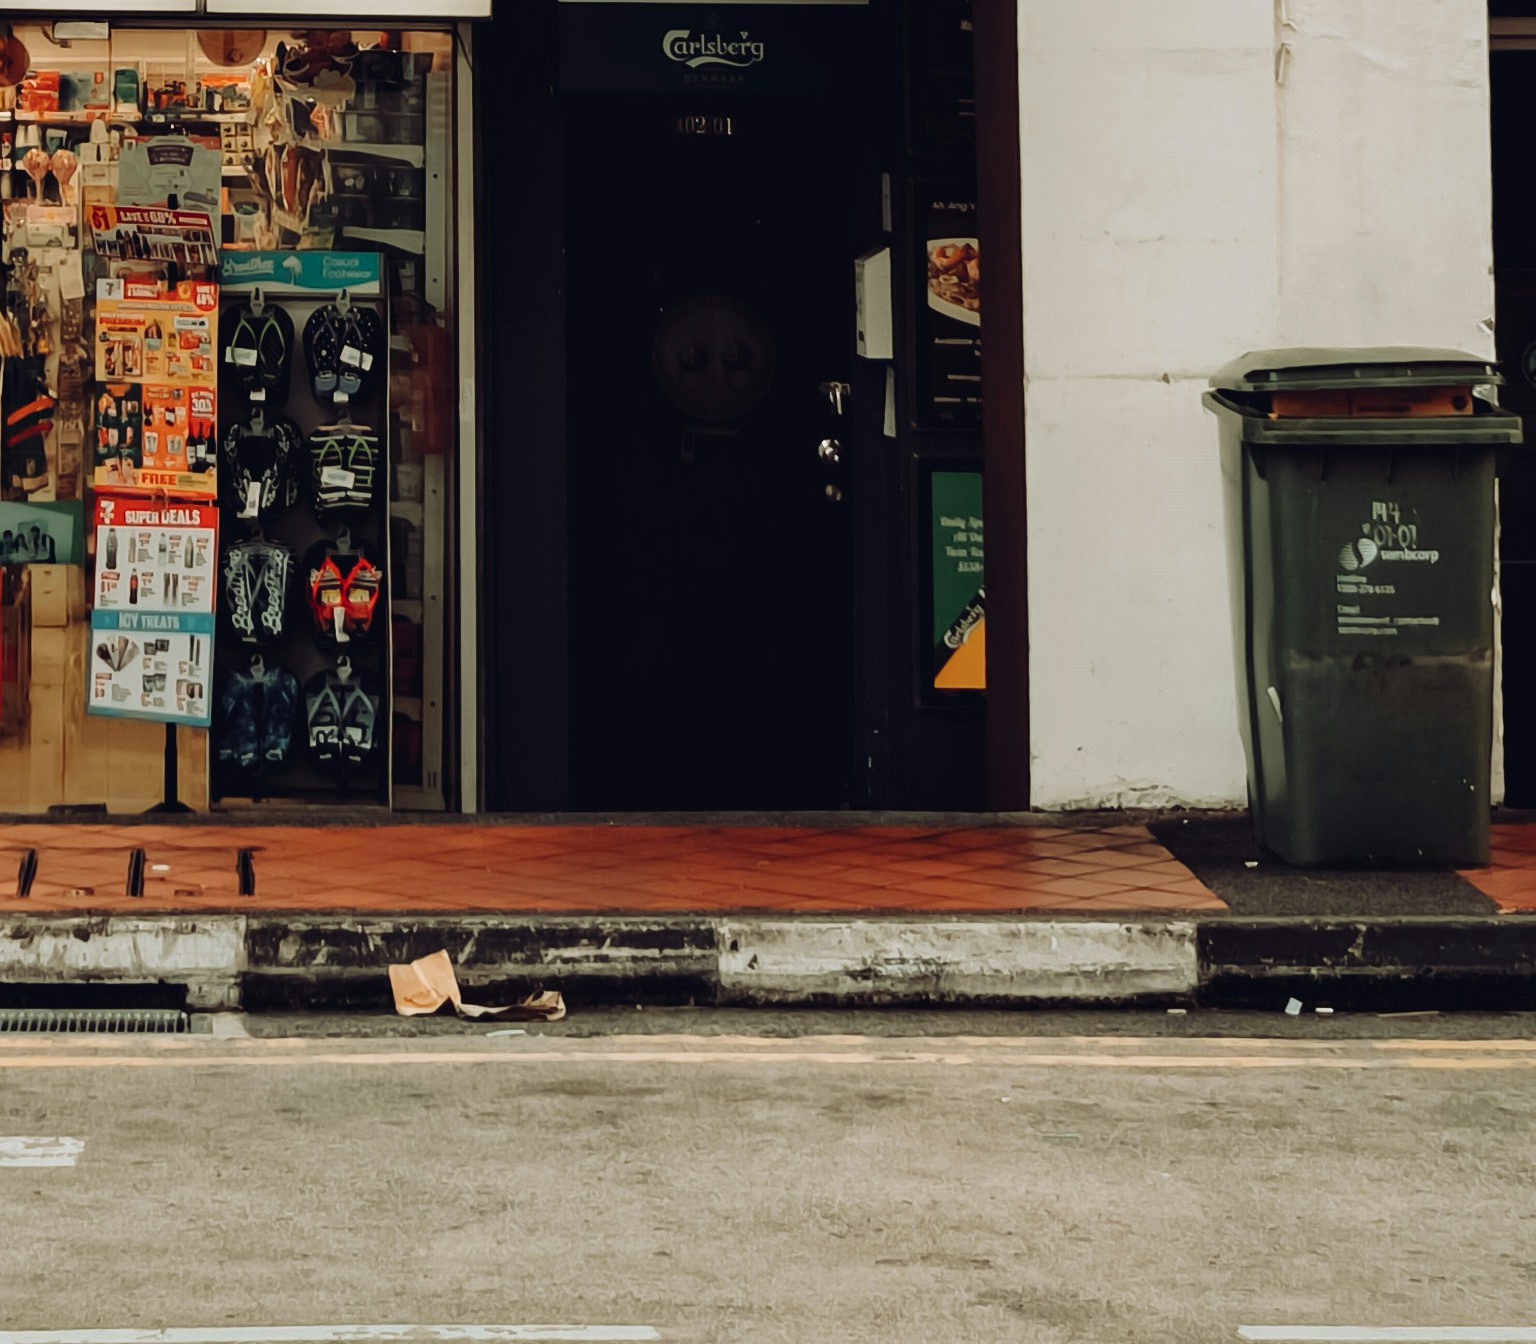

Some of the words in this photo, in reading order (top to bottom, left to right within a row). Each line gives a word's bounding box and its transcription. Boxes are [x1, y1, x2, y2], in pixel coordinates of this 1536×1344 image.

[662, 29, 764, 65] Carlsberg
[141, 472, 177, 485] FREE
[125, 510, 159, 524] SUPER
[161, 509, 201, 525] DEALS
